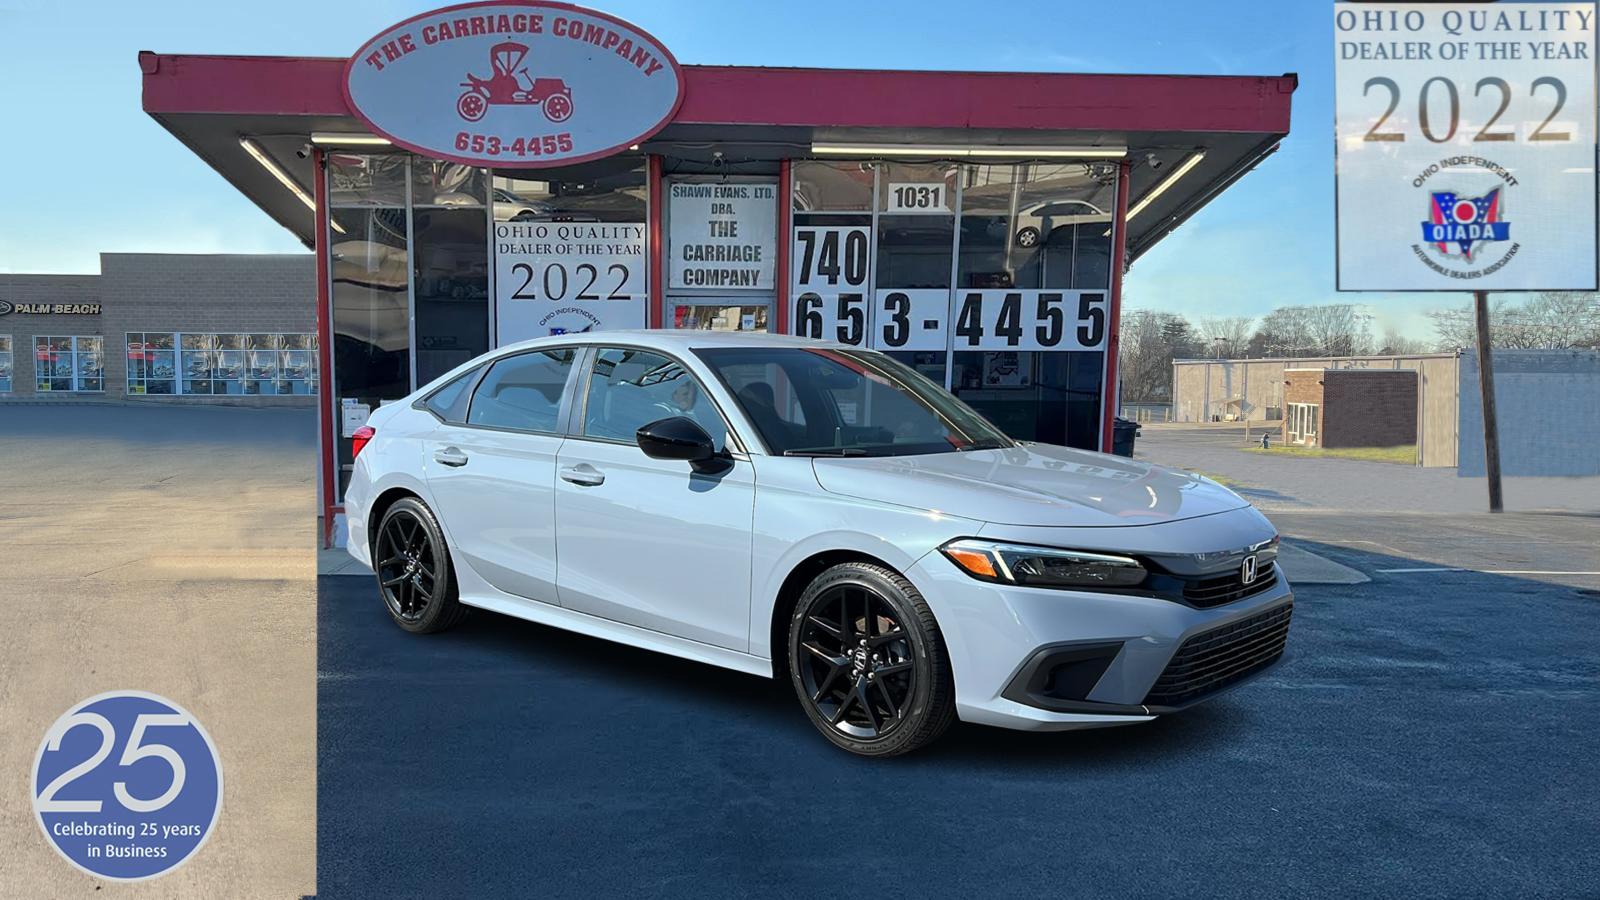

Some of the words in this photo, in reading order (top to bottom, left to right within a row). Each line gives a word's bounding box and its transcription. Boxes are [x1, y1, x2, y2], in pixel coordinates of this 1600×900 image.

[1336, 10, 1424, 31] OHIO
[1442, 10, 1593, 35] QUALITY
[366, 34, 416, 71] THE
[423, 14, 543, 45] CARRIAGE
[553, 17, 663, 77] COMPANY
[1341, 42, 1433, 60] DEALER
[1439, 42, 1469, 60] OF
[1475, 42, 1522, 60] THE
[1528, 42, 1589, 60] YEAR
[1363, 76, 1570, 143] 2022
[455, 132, 573, 156] 653-4455
[1412, 164, 1439, 188] OHIO
[1440, 156, 1519, 187] INDEPENDENT
[673, 186, 712, 198] SHAWN
[754, 187, 774, 199] LTD.
[894, 186, 940, 208] 1031
[711, 203, 735, 215] DBA.
[497, 226, 548, 239] OHIO
[558, 226, 644, 241] QUALITY
[709, 221, 737, 238] THE
[1432, 224, 1495, 240] OIADA
[500, 244, 552, 254] DEALER
[555, 244, 573, 254] OF
[576, 244, 602, 255] THE
[607, 244, 641, 255] YEAR
[683, 244, 761, 262] CARRIAGE
[798, 230, 868, 286] 740
[1411, 244, 1449, 277] AUTOMOBILE
[1450, 270, 1482, 279] DEALERS
[1482, 242, 1520, 276] ASSOCIATION
[511, 263, 631, 301] 2022
[683, 268, 760, 286] COMPANY
[15, 303, 51, 314] PALM
[55, 303, 100, 314] BEACH
[539, 312, 555, 326] OHIO
[555, 307, 601, 326] INDEPENDENT
